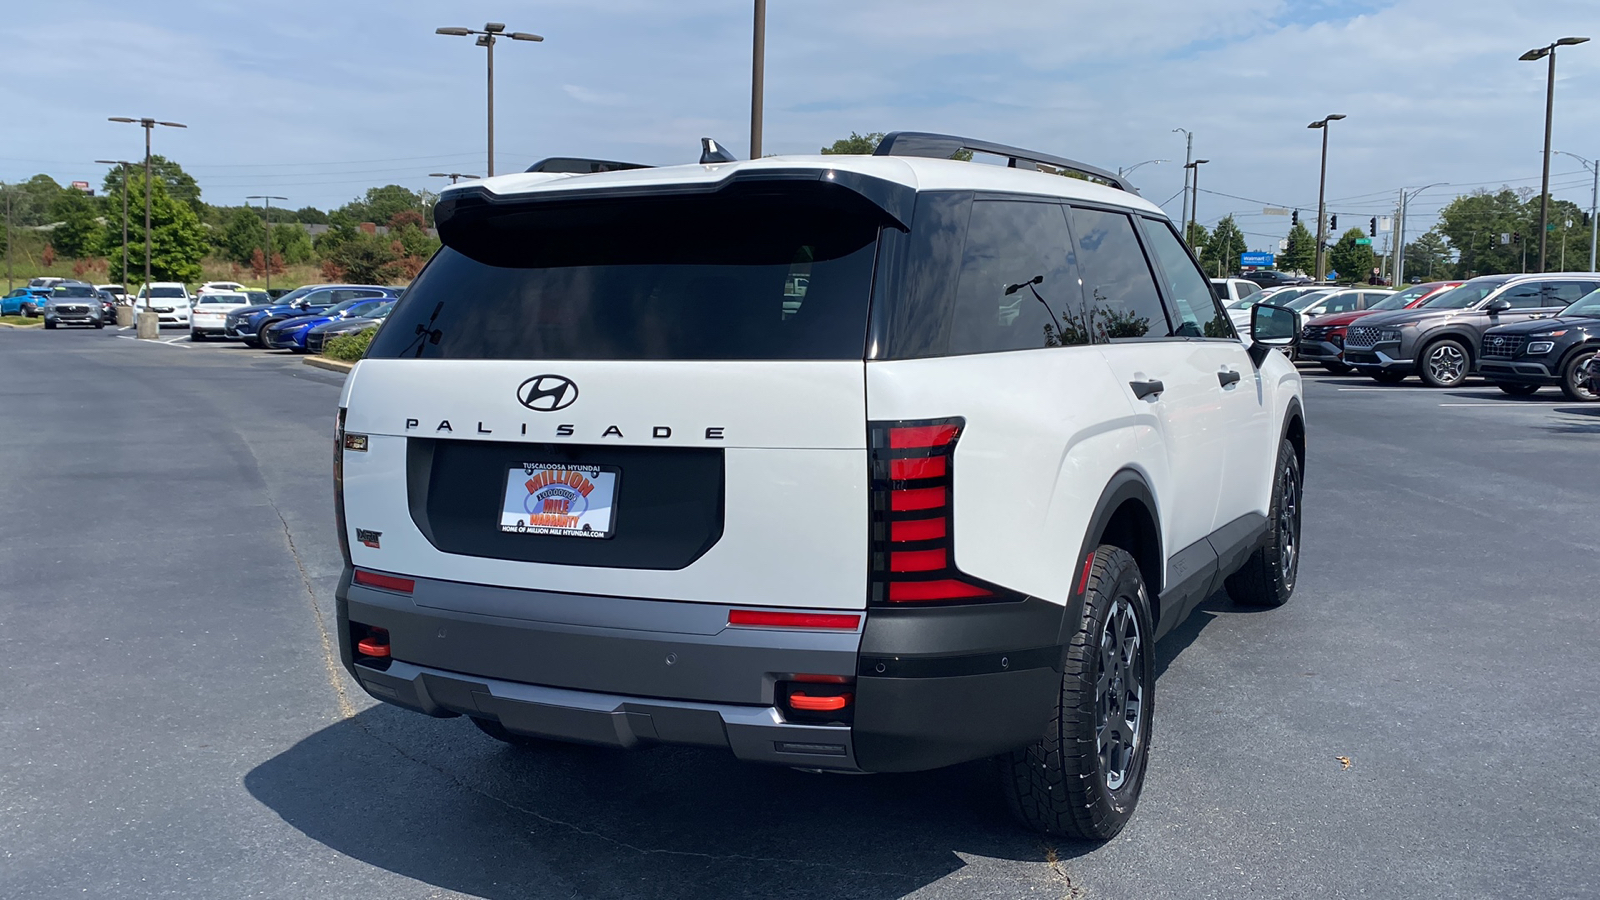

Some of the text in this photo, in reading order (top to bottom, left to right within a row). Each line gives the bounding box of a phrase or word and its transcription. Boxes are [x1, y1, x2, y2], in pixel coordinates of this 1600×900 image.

[406, 418, 725, 439] PALISADE
[523, 463, 566, 471] TUSCALOOSA
[525, 470, 594, 497] MILLION
[543, 498, 570, 515] MILE
[530, 513, 580, 528] WARRANTY
[355, 527, 383, 542] XRT
[563, 530, 605, 538] HYUNDAI.COM
